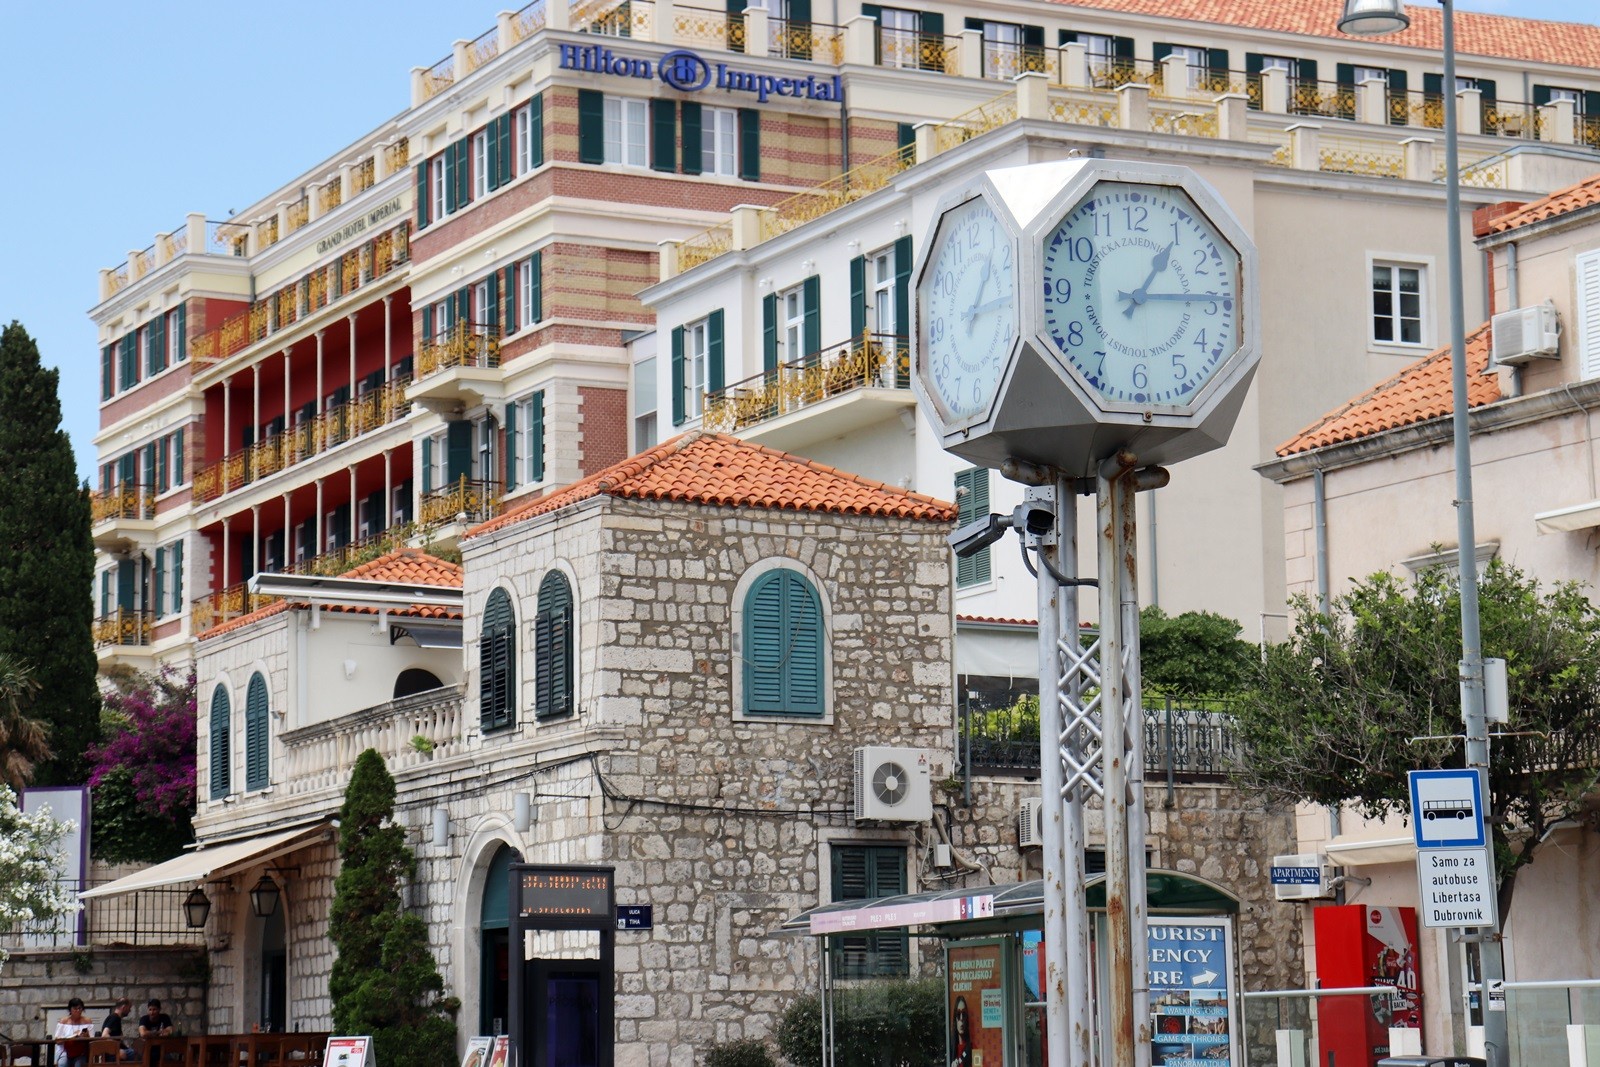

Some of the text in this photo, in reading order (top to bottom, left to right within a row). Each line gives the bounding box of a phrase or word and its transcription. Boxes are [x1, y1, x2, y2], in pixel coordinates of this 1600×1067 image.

[558, 43, 843, 104] Hilton Imperial
[316, 197, 402, 255] GRAND HOTEL IMPERIAL
[1090, 211, 1113, 238] 11
[1122, 206, 1149, 233] 12
[966, 222, 980, 249] 12
[1170, 221, 1181, 246] 1
[951, 241, 963, 266] 11
[1002, 245, 1011, 271] 2
[1064, 236, 1094, 264] 10
[1193, 249, 1210, 276] 2
[940, 271, 954, 299] 10
[1055, 278, 1072, 305] 9
[936, 317, 945, 342] 9
[1067, 320, 1084, 347] 8
[1085, 305, 1192, 358] DUBROVNIK TOURIST BOARD
[1193, 328, 1208, 354] 4
[942, 354, 950, 379] 8
[1093, 351, 1107, 377] 7
[1132, 363, 1148, 389] 6
[1172, 354, 1188, 380] 5
[954, 376, 962, 401] 7
[972, 378, 982, 404] 6
[1272, 868, 1320, 878] APARTMENTS
[1432, 856, 1475, 868] Samo za
[1432, 874, 1478, 886] autobuse
[961, 904, 966, 914] 5
[981, 902, 986, 911] 4
[1432, 891, 1481, 904] Libertasa
[1434, 909, 1483, 922] Dubrovnik
[975, 958, 995, 968] PAKET
[1167, 1007, 1200, 1015] WALKING
[1157, 1034, 1226, 1043] GAME OF THRONES
